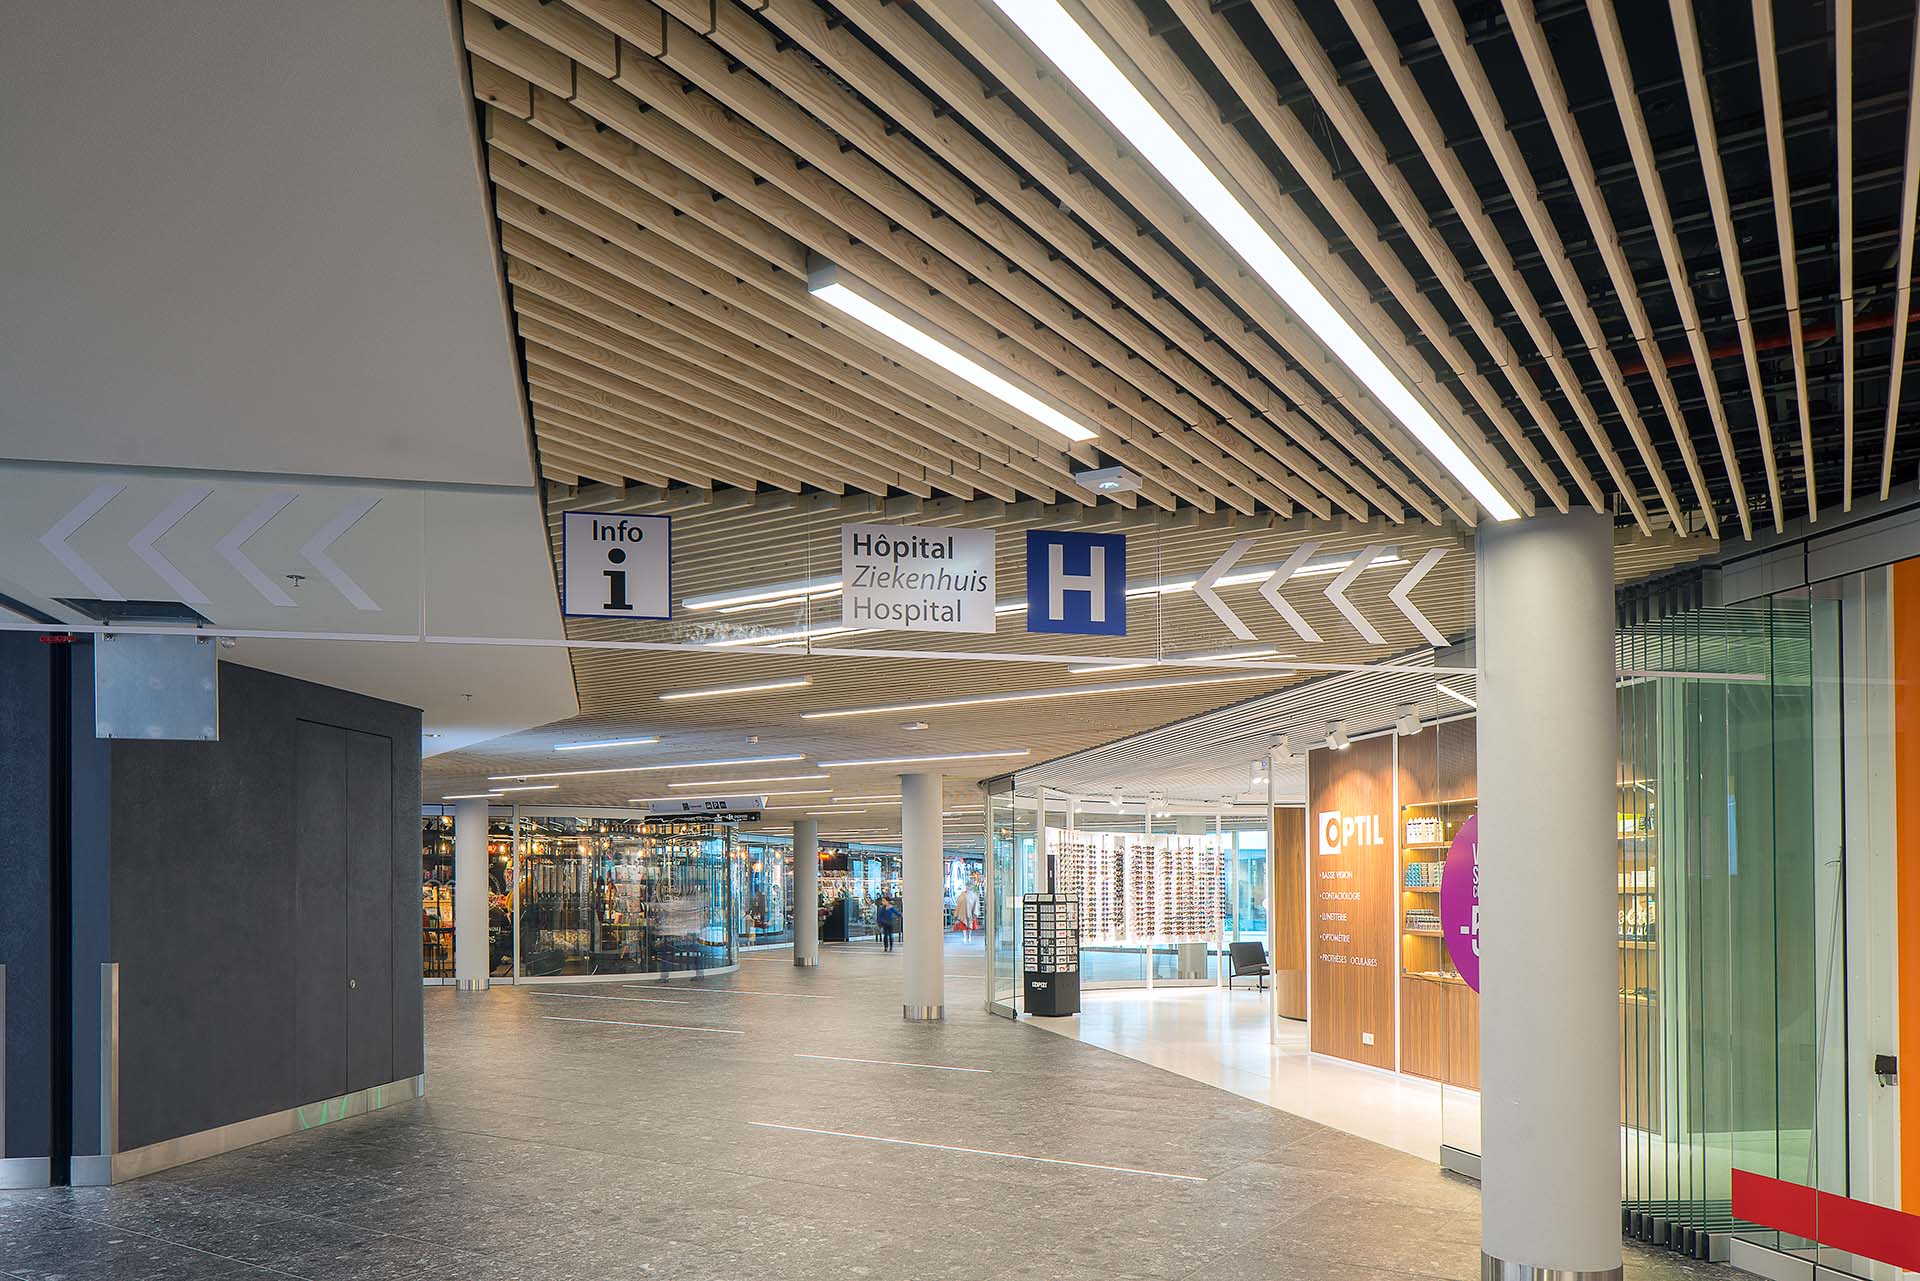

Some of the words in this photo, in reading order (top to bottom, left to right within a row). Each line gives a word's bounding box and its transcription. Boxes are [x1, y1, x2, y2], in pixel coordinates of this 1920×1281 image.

[592, 519, 644, 543] Info
[853, 533, 953, 563] Hôpital
[852, 564, 988, 592] Ziekenhuis
[1048, 543, 1105, 622] H
[854, 596, 961, 626] Hospital
[1322, 814, 1384, 850] OPTIL
